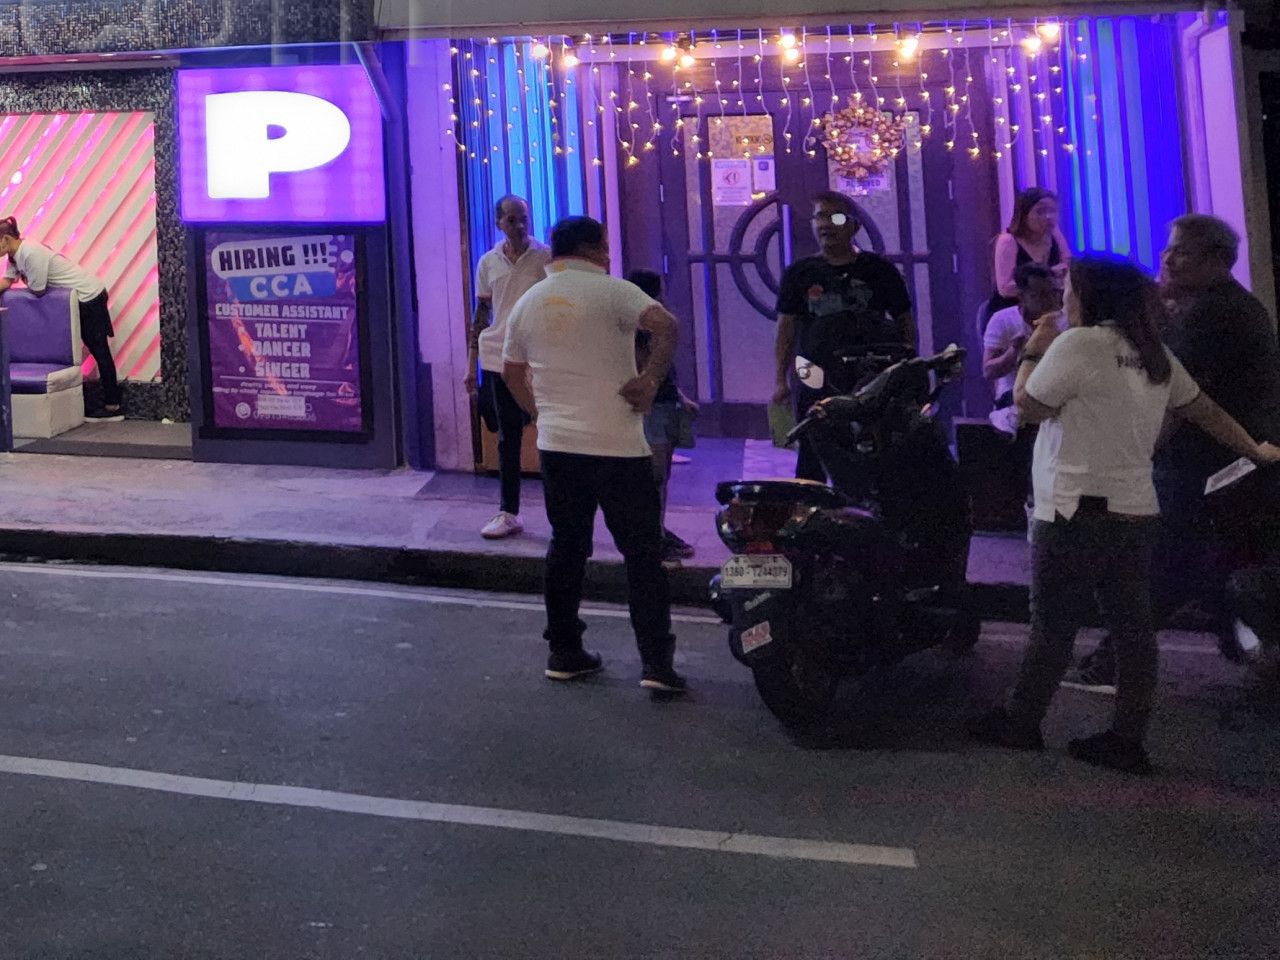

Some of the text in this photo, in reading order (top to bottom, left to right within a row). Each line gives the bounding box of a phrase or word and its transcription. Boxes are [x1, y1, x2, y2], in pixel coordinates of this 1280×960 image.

[206, 90, 351, 199] P
[219, 245, 295, 272] HIRING
[250, 275, 313, 299] CCA
[215, 303, 349, 320] CUSTOMER ASSISTANT
[255, 322, 308, 339] TALENT
[252, 341, 311, 357] DANCER
[255, 362, 310, 378] SINGER
